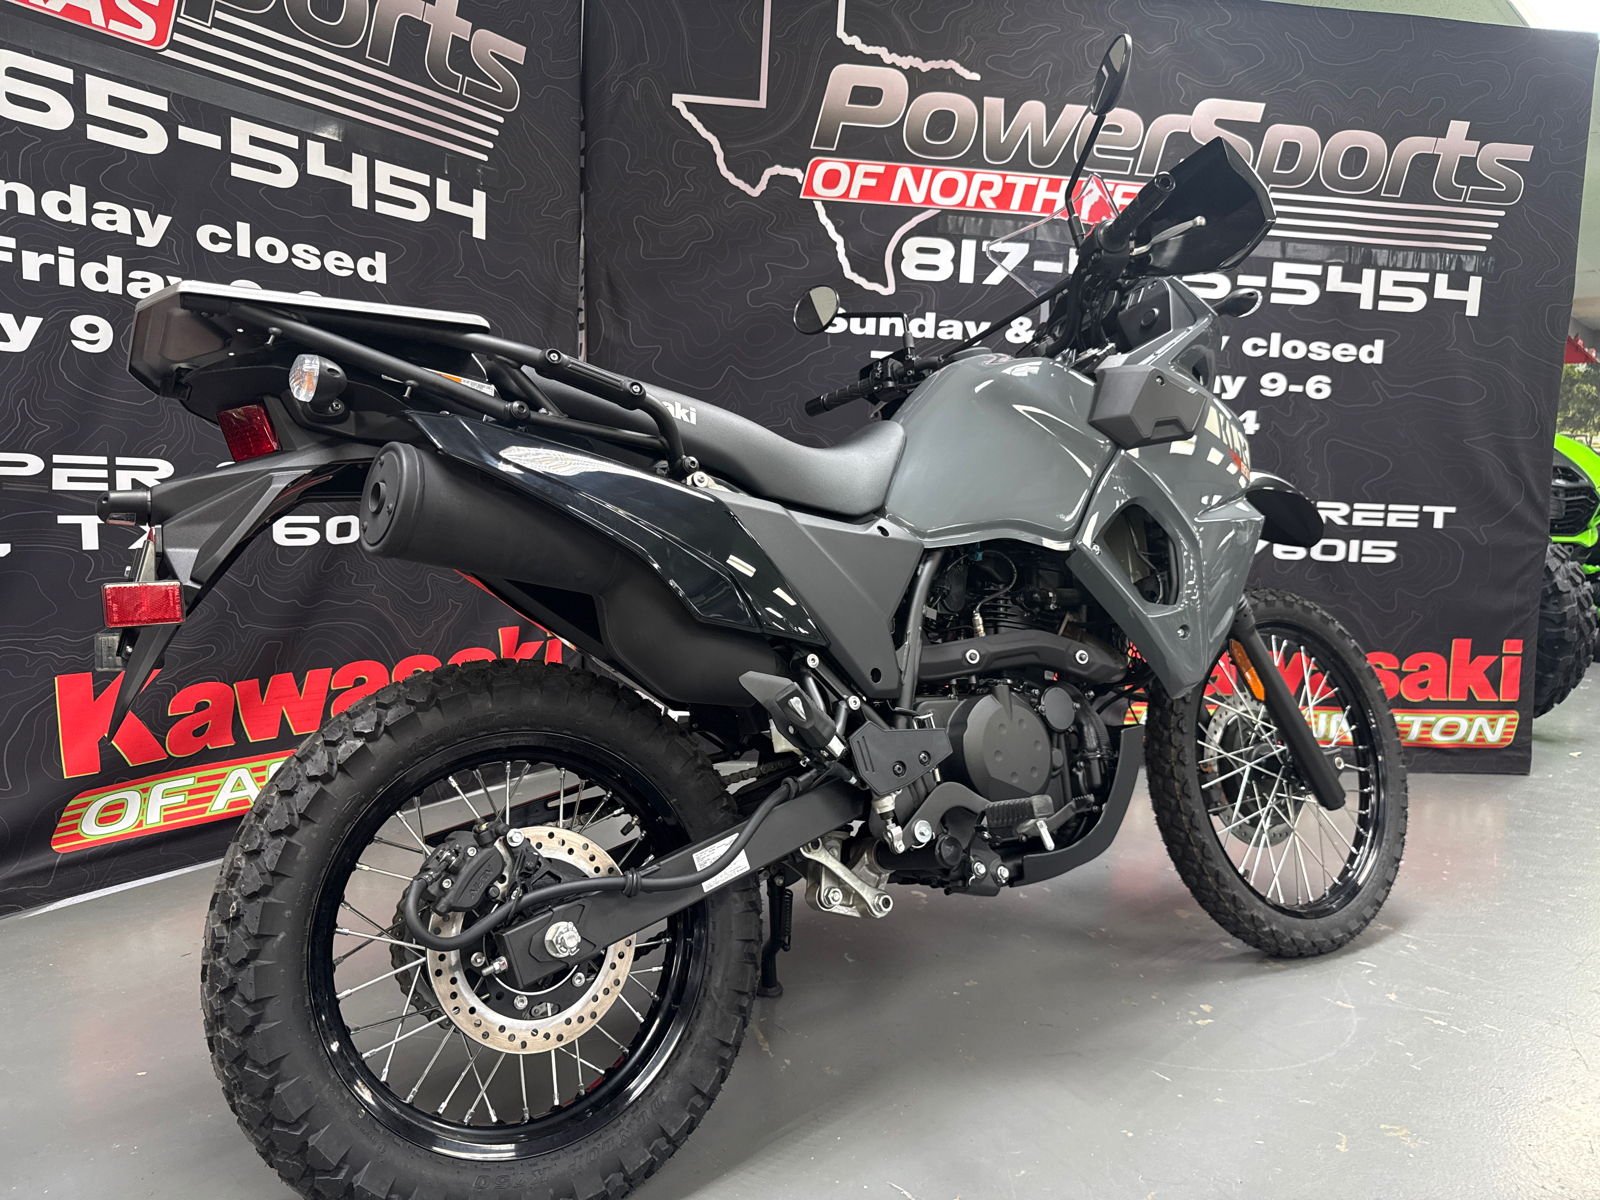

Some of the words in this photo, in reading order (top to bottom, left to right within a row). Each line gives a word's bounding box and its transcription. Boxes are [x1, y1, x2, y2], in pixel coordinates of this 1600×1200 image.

[0, 49, 486, 240] 65-5454
[812, 161, 885, 200] OF
[890, 166, 1073, 213] NORTH
[0, 179, 172, 248] nday
[196, 220, 387, 285] closed
[901, 236, 1482, 317] 817--5454
[1004, 316, 1036, 344] &
[1241, 332, 1385, 364] closed
[1260, 372, 1332, 400] 9-6
[80, 777, 195, 838] OF
